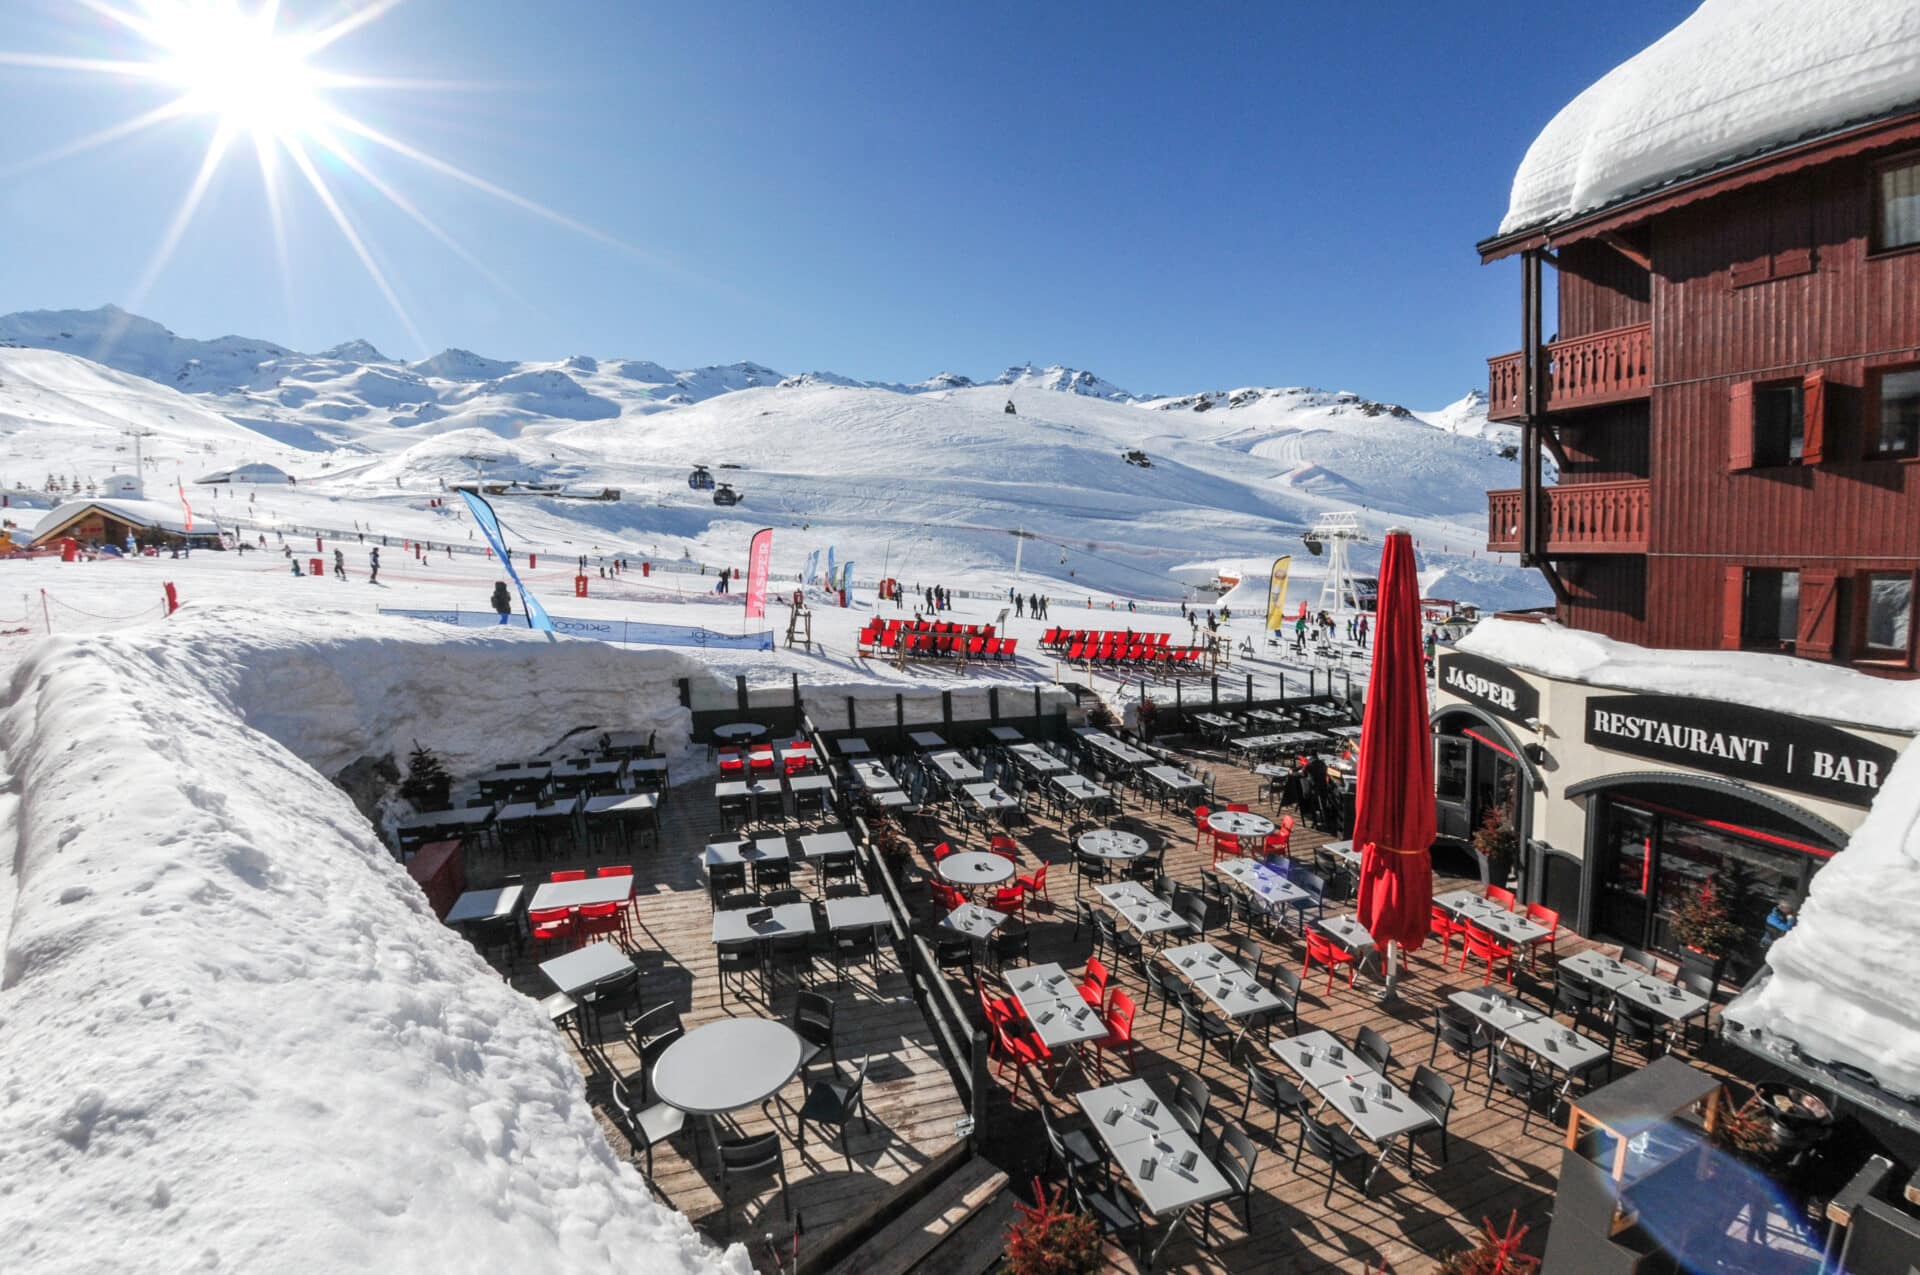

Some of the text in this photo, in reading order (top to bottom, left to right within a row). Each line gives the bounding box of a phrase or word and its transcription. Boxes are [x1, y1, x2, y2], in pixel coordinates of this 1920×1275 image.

[752, 543, 769, 611] JASPER
[1446, 666, 1517, 711] JASPER
[1593, 710, 1769, 765] RESTAURANT
[1812, 751, 1879, 788] BAR
